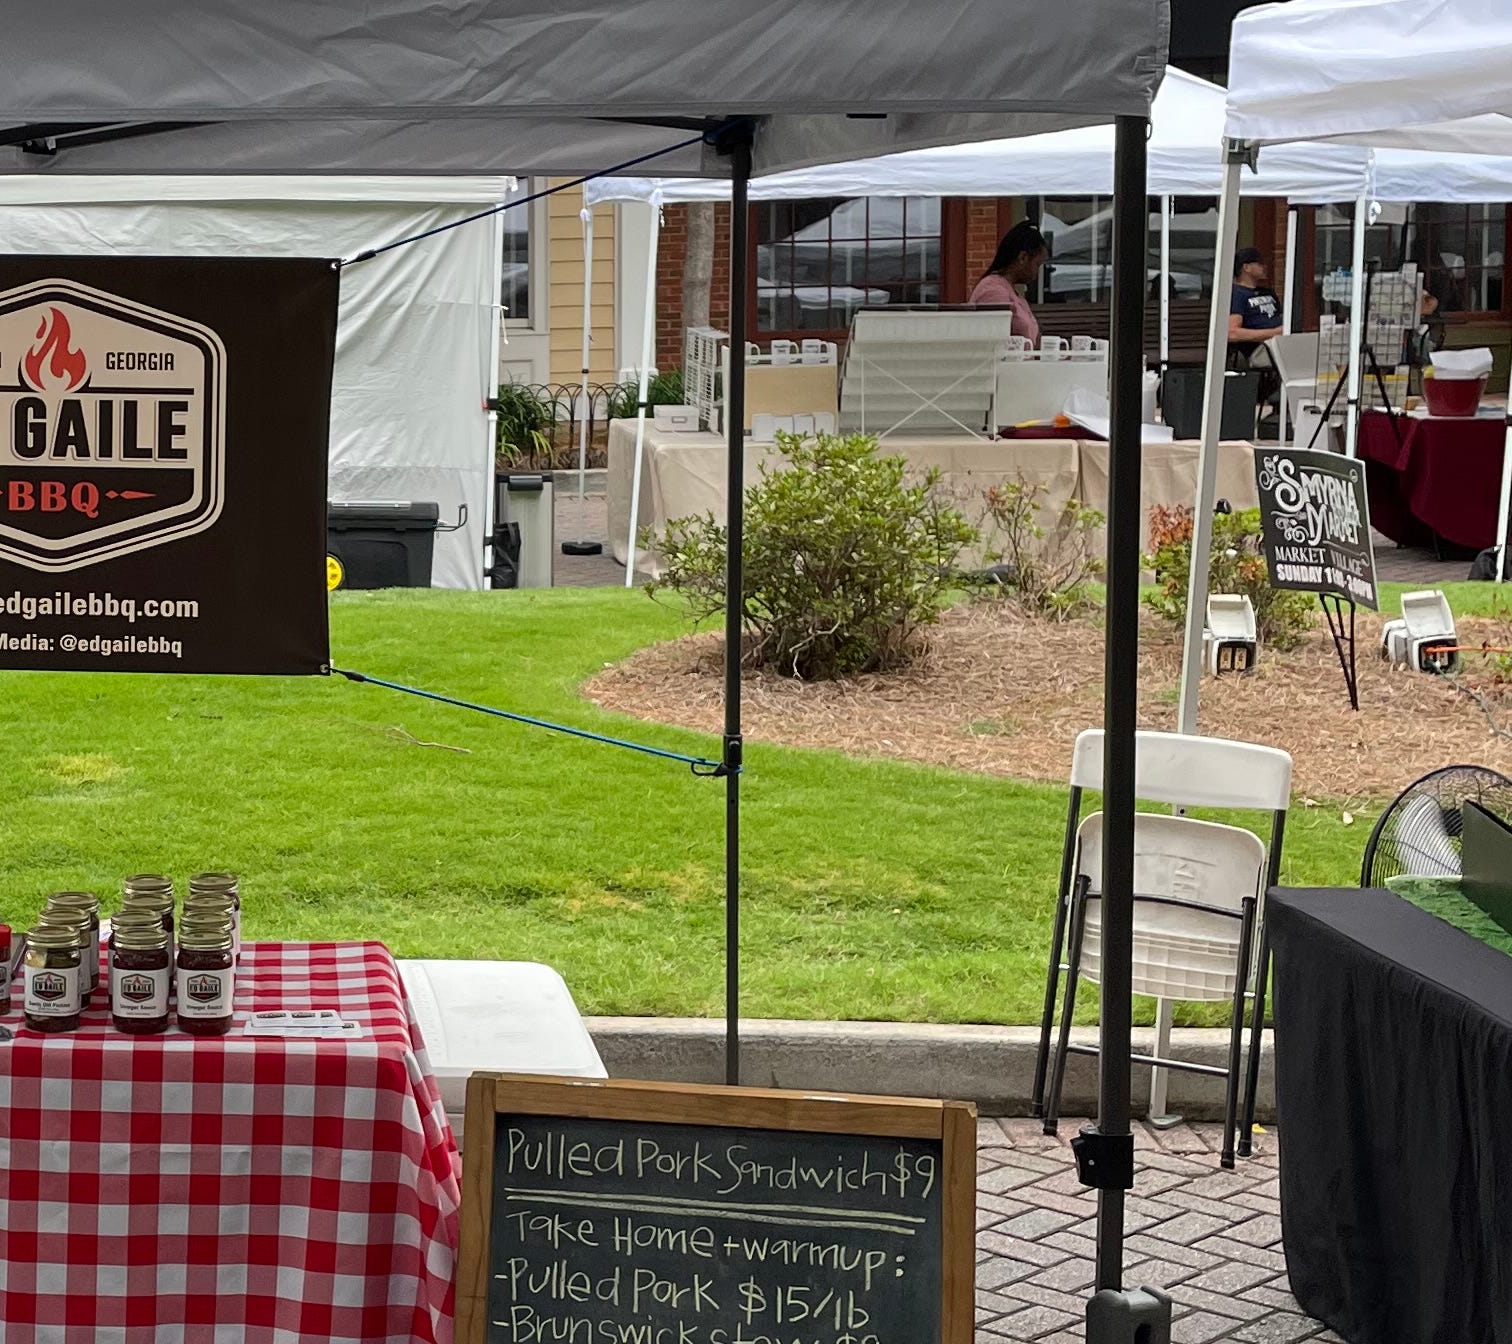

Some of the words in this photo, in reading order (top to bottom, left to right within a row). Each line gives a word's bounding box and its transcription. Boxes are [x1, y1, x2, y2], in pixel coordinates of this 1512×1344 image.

[105, 351, 176, 373] GEORGIA
[12, 397, 189, 462] GAILE
[7, 481, 100, 519] BBQ
[1274, 545, 1326, 564] MARKET
[1276, 563, 1323, 584] SUNDAY
[59, 633, 183, 658] @edgailebbq
[507, 1128, 624, 1179] Pulled
[637, 1138, 722, 1180] Pork
[716, 1145, 887, 1197] Sandwich
[889, 1146, 937, 1200] $9
[506, 1210, 599, 1247] Take
[613, 1217, 715, 1257] Home
[632, 1268, 720, 1314] Pork
